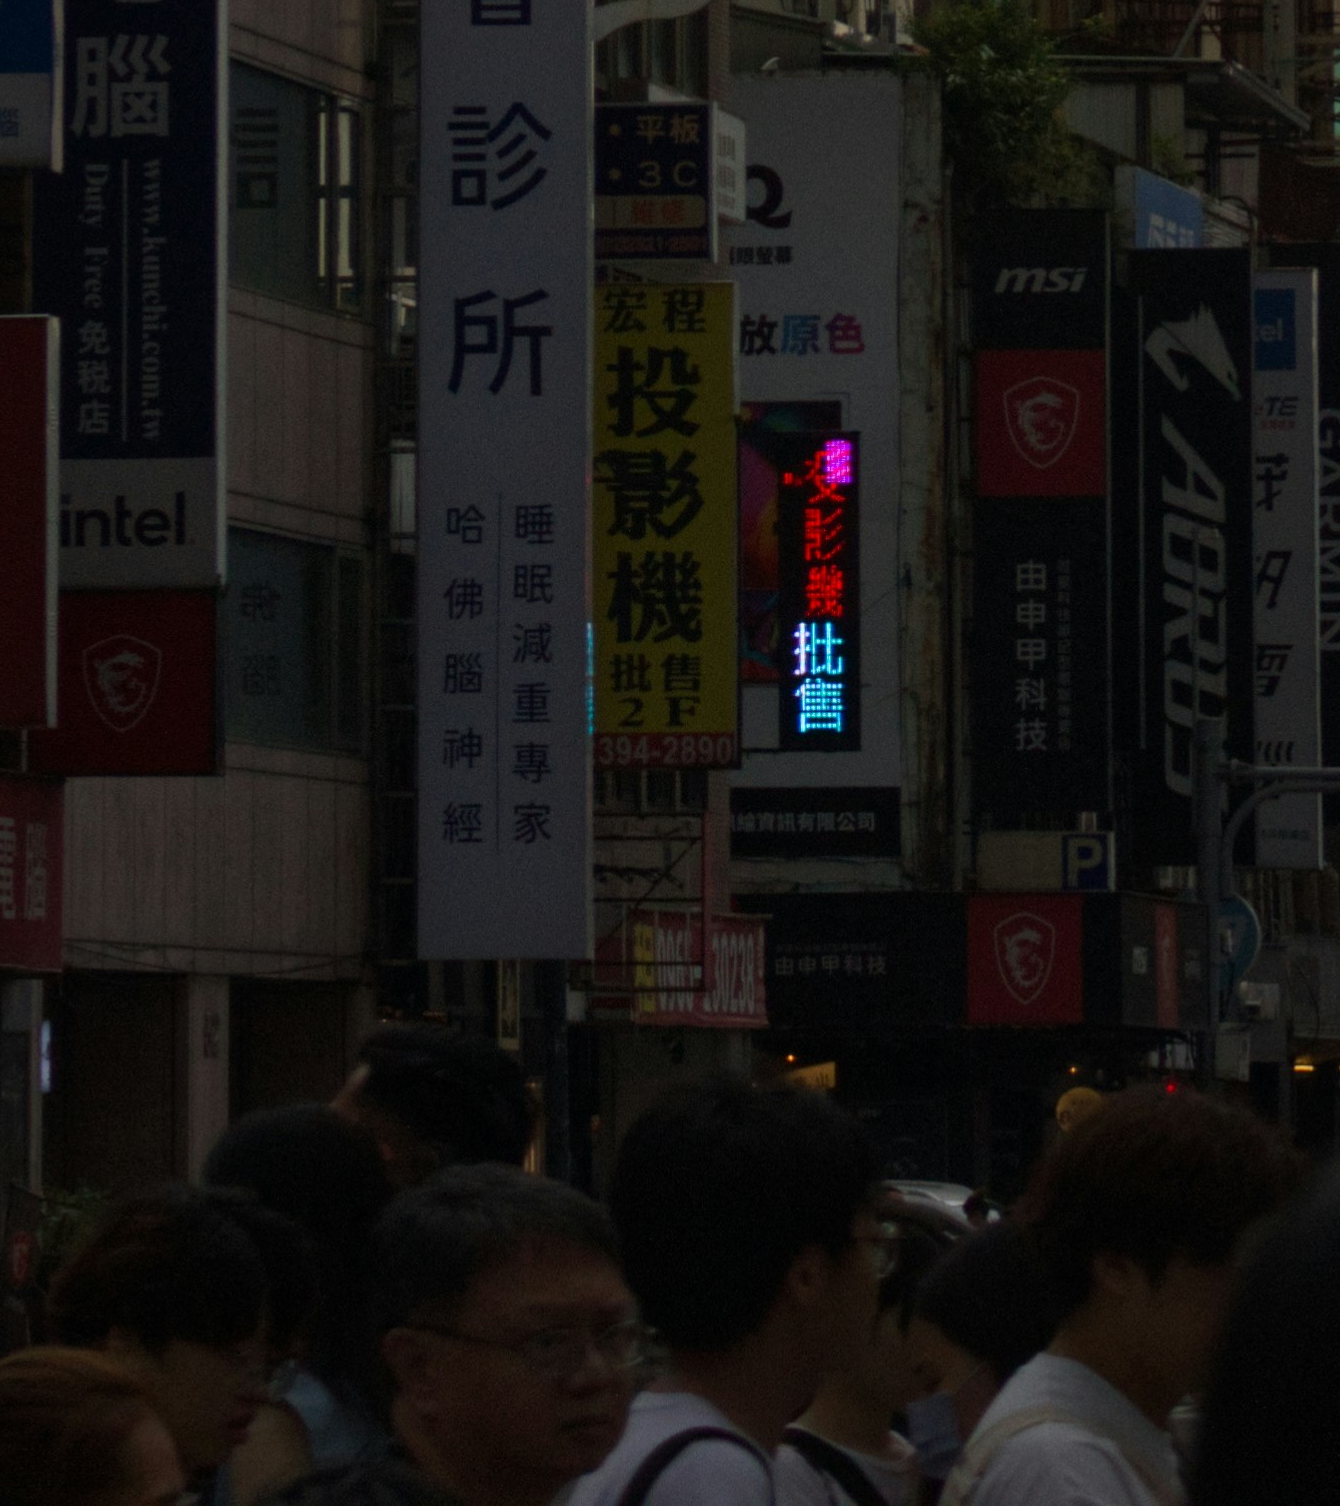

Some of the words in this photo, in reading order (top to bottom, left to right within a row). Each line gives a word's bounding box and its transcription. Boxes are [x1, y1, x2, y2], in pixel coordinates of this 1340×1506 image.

[636, 113, 700, 145] 平板
[78, 164, 110, 228] Duty
[83, 246, 109, 308] Free
[141, 158, 167, 440] www.kunchi.com.tw
[993, 265, 1087, 295] msi
[60, 492, 189, 548] intel
[604, 345, 704, 645] 投影機
[441, 503, 486, 845] 哈佛腦神經
[512, 502, 555, 845] 睡眠減重專家
[609, 654, 703, 695] 批售
[1014, 560, 1049, 753] 由申甲科技
[617, 695, 701, 728] 2F
[1072, 835, 1105, 878] P
